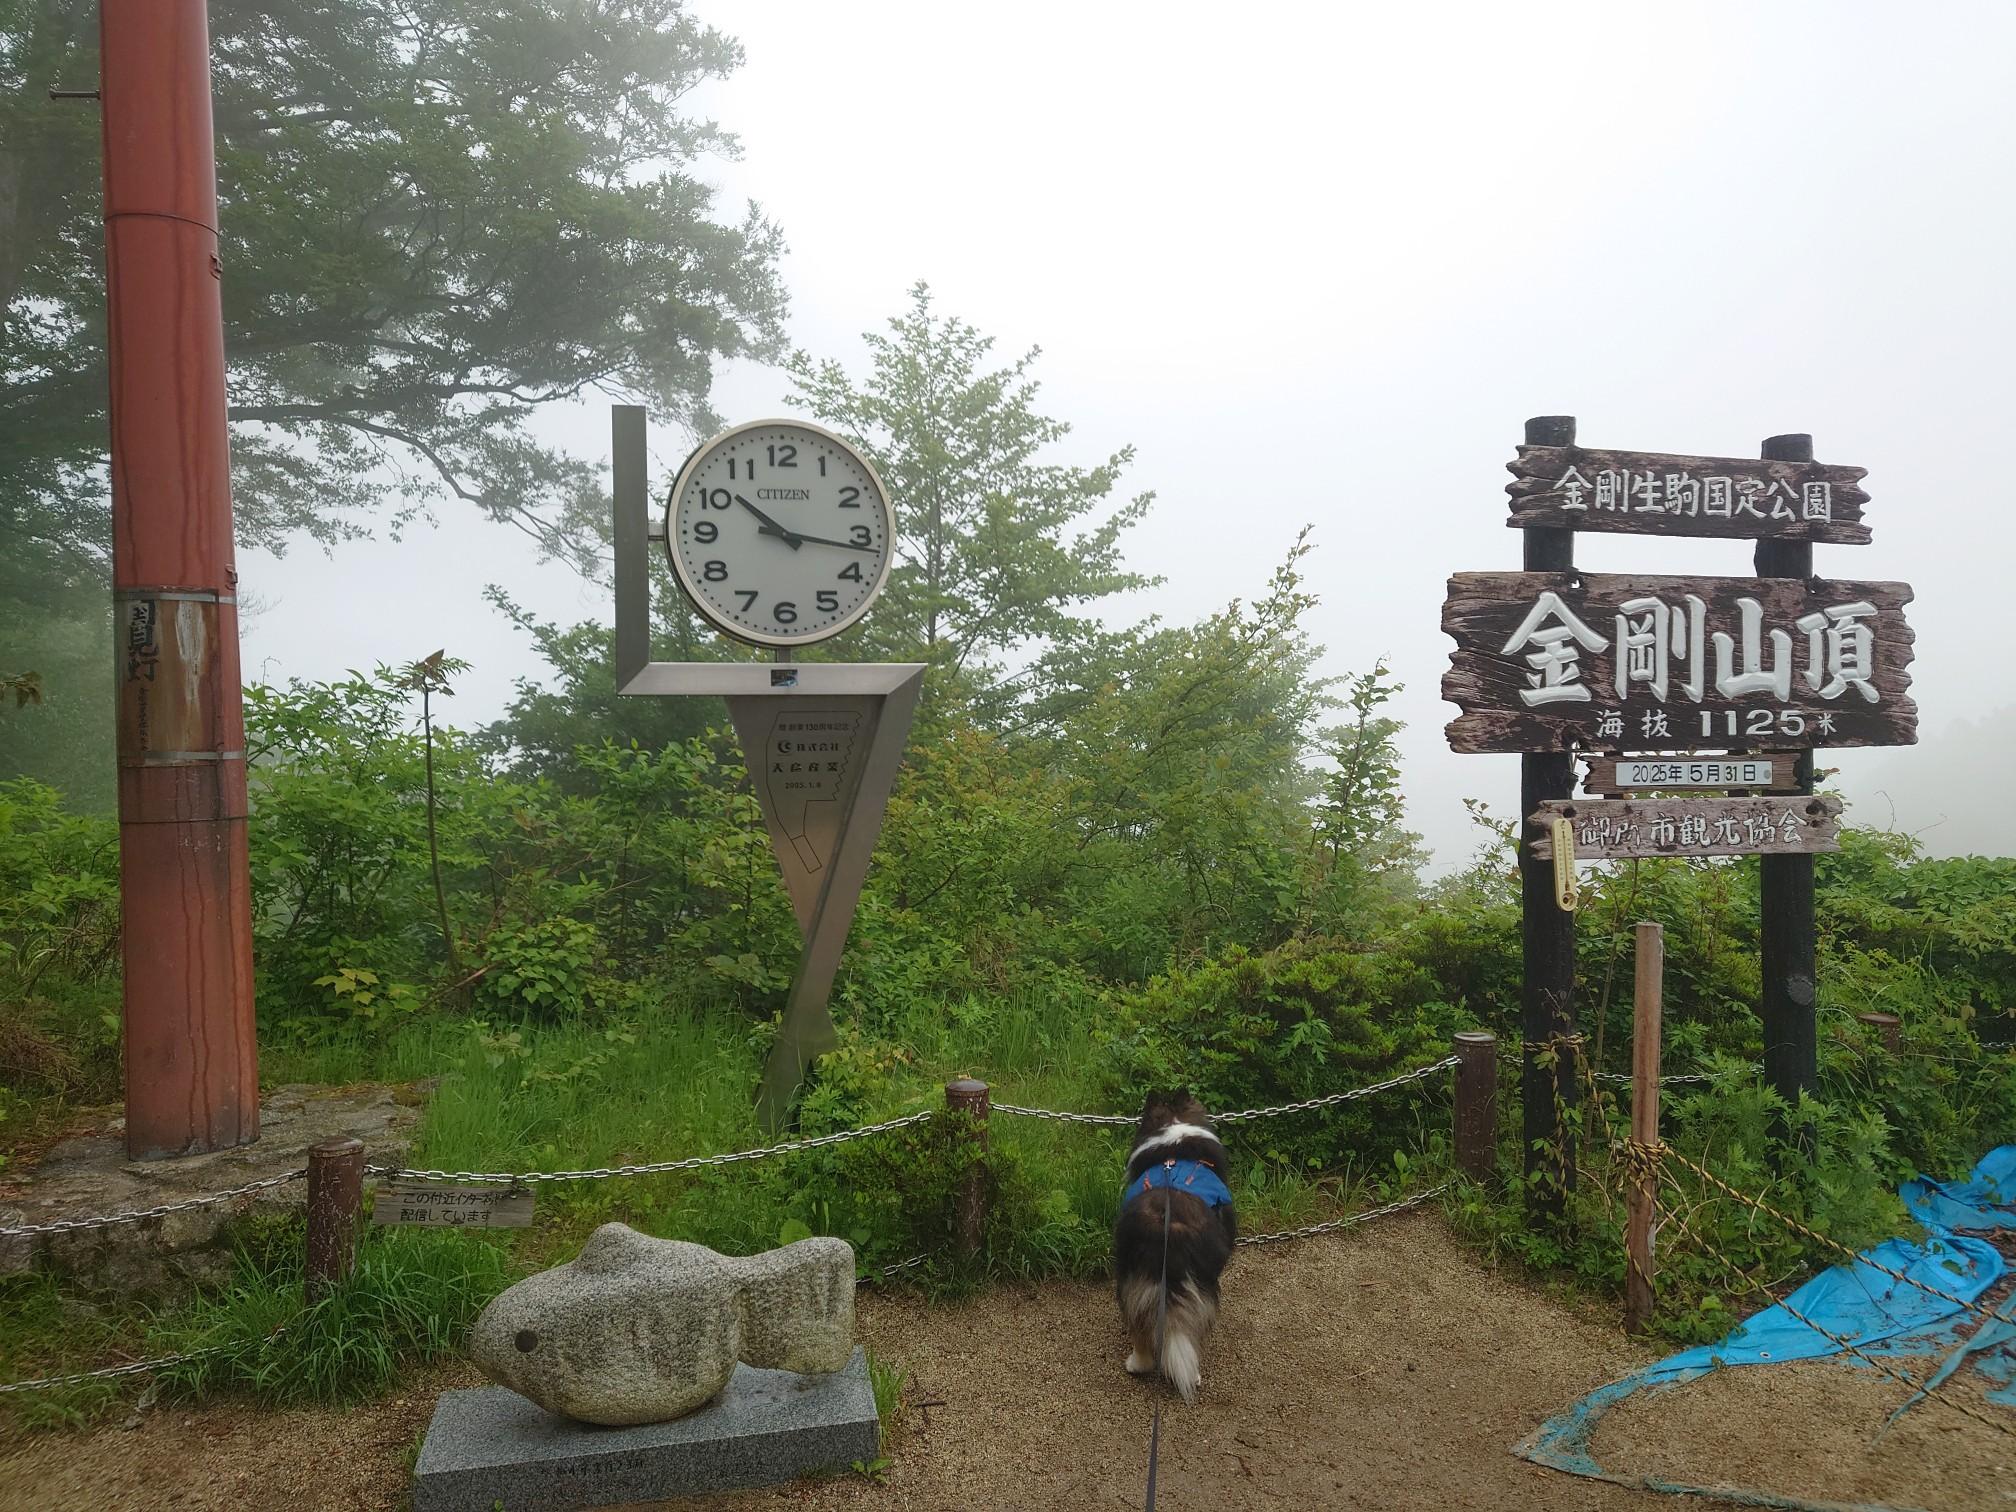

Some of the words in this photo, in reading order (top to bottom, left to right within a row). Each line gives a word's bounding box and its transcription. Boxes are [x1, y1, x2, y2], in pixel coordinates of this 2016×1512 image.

[767, 445, 798, 467] 12
[817, 456, 827, 477] 1
[728, 458, 754, 480] 11
[699, 488, 732, 510] 10
[757, 489, 810, 500] CITIZEN
[838, 486, 860, 508] 2
[1553, 465, 1831, 523] 金剛生駒国定公園
[694, 521, 718, 544] 9
[849, 525, 872, 547] 3
[703, 560, 728, 582] 8
[837, 562, 863, 583] 4
[734, 590, 759, 612] 7
[816, 590, 839, 612] 5
[773, 602, 798, 624] 6
[1501, 591, 1880, 706] 金剛山頂
[1580, 808, 1807, 847] 御所市観光協会
[400, 1209, 492, 1222] 配信しています
